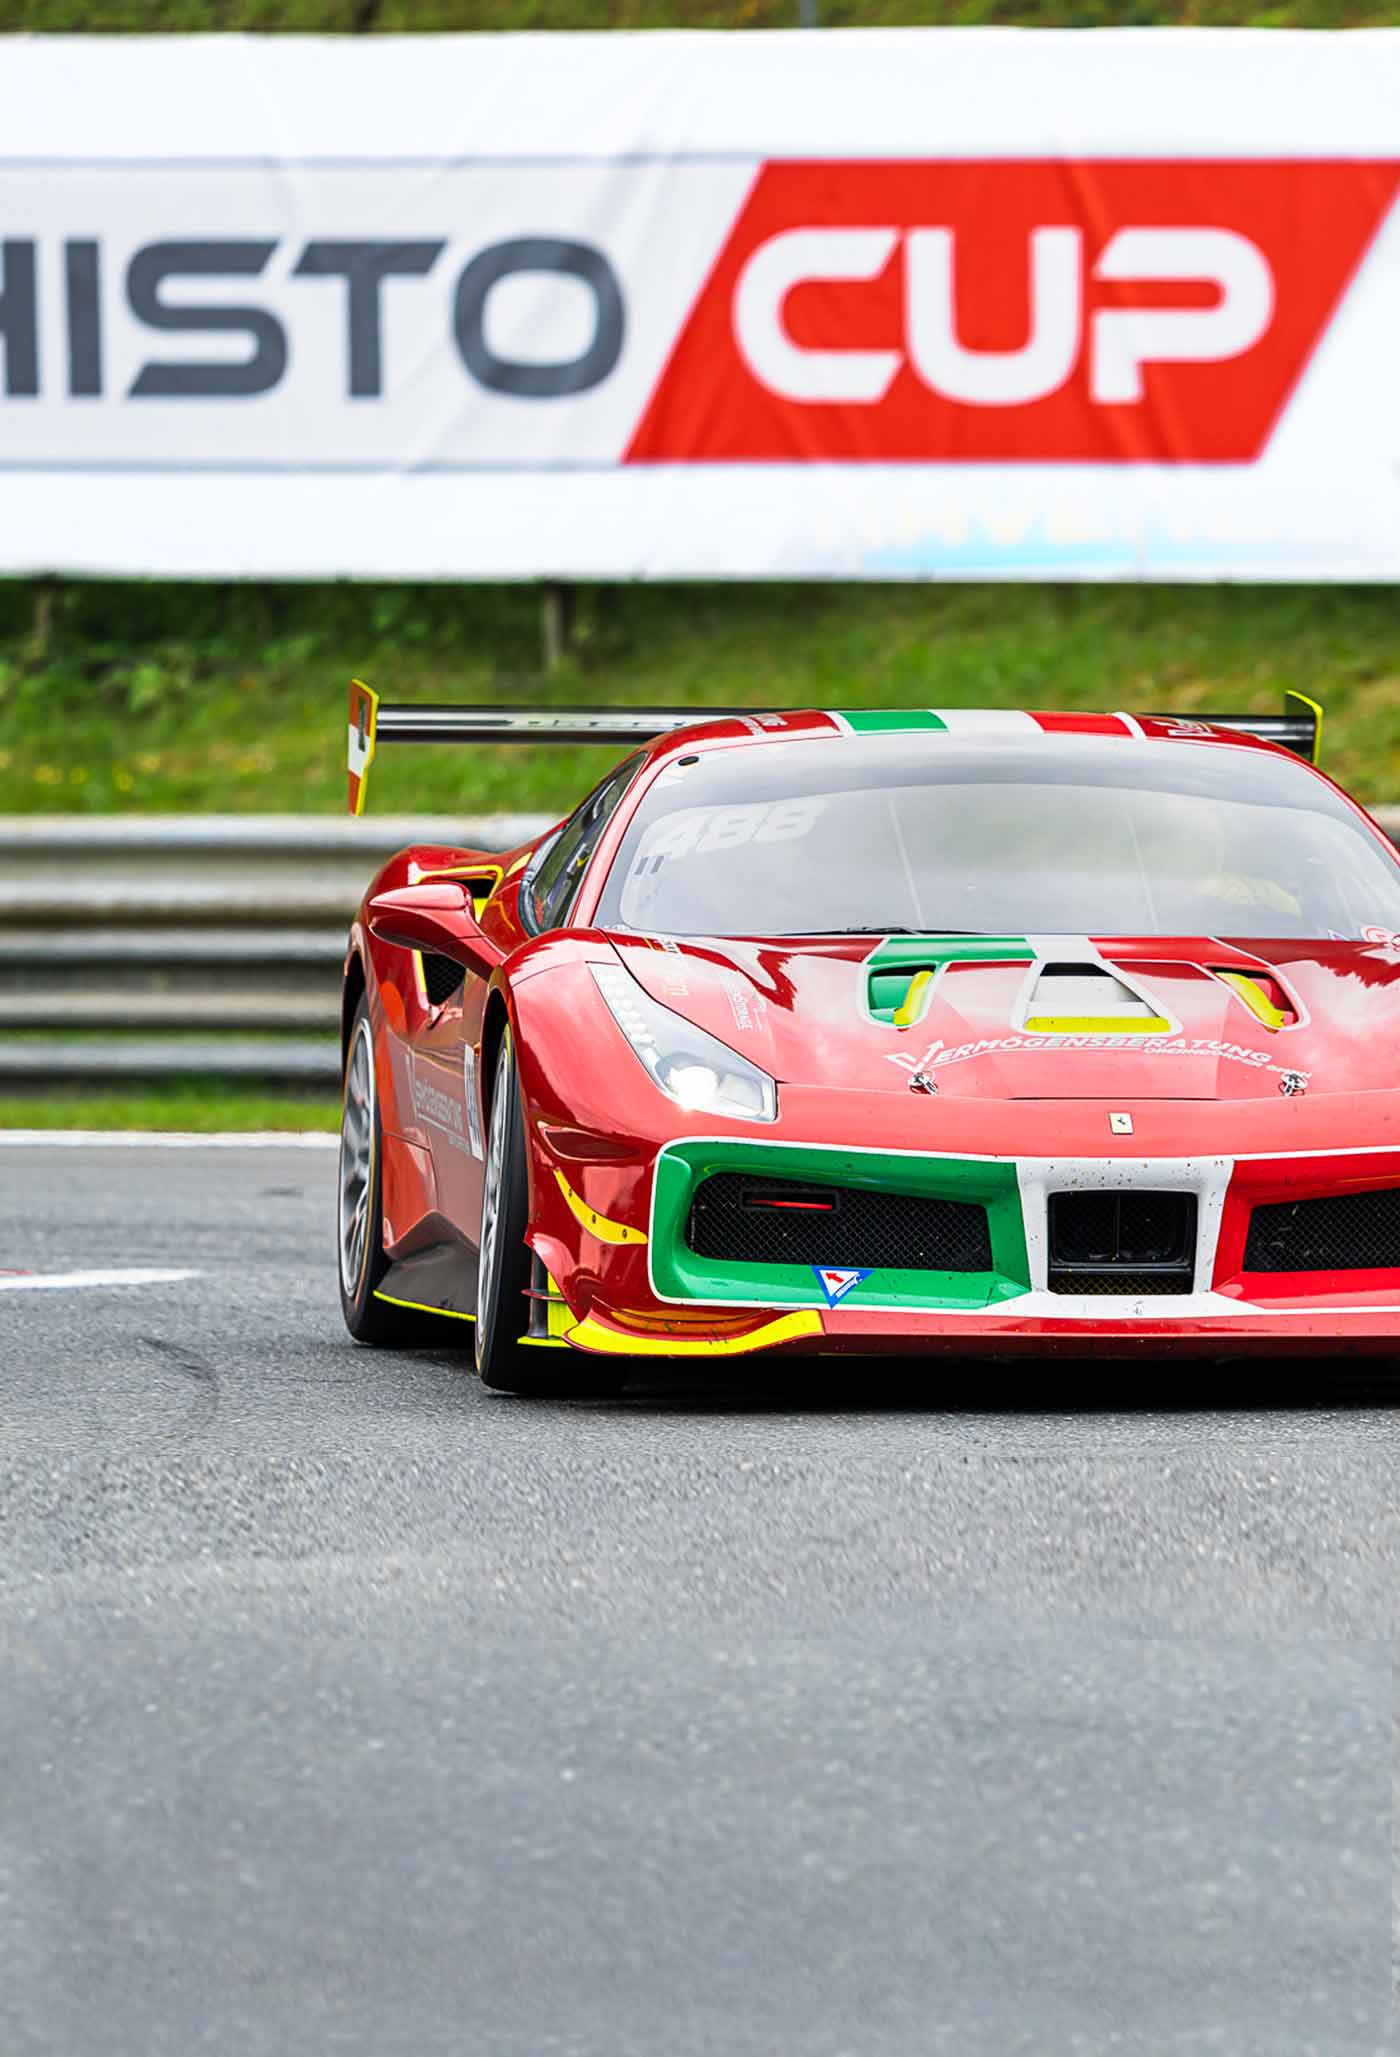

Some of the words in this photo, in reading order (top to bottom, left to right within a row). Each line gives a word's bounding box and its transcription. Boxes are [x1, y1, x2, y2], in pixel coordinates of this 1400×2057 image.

[733, 228, 1273, 404] CUP
[647, 801, 826, 860] 488
[885, 1037, 1271, 1072] VERMÖGENSBERATUNG
